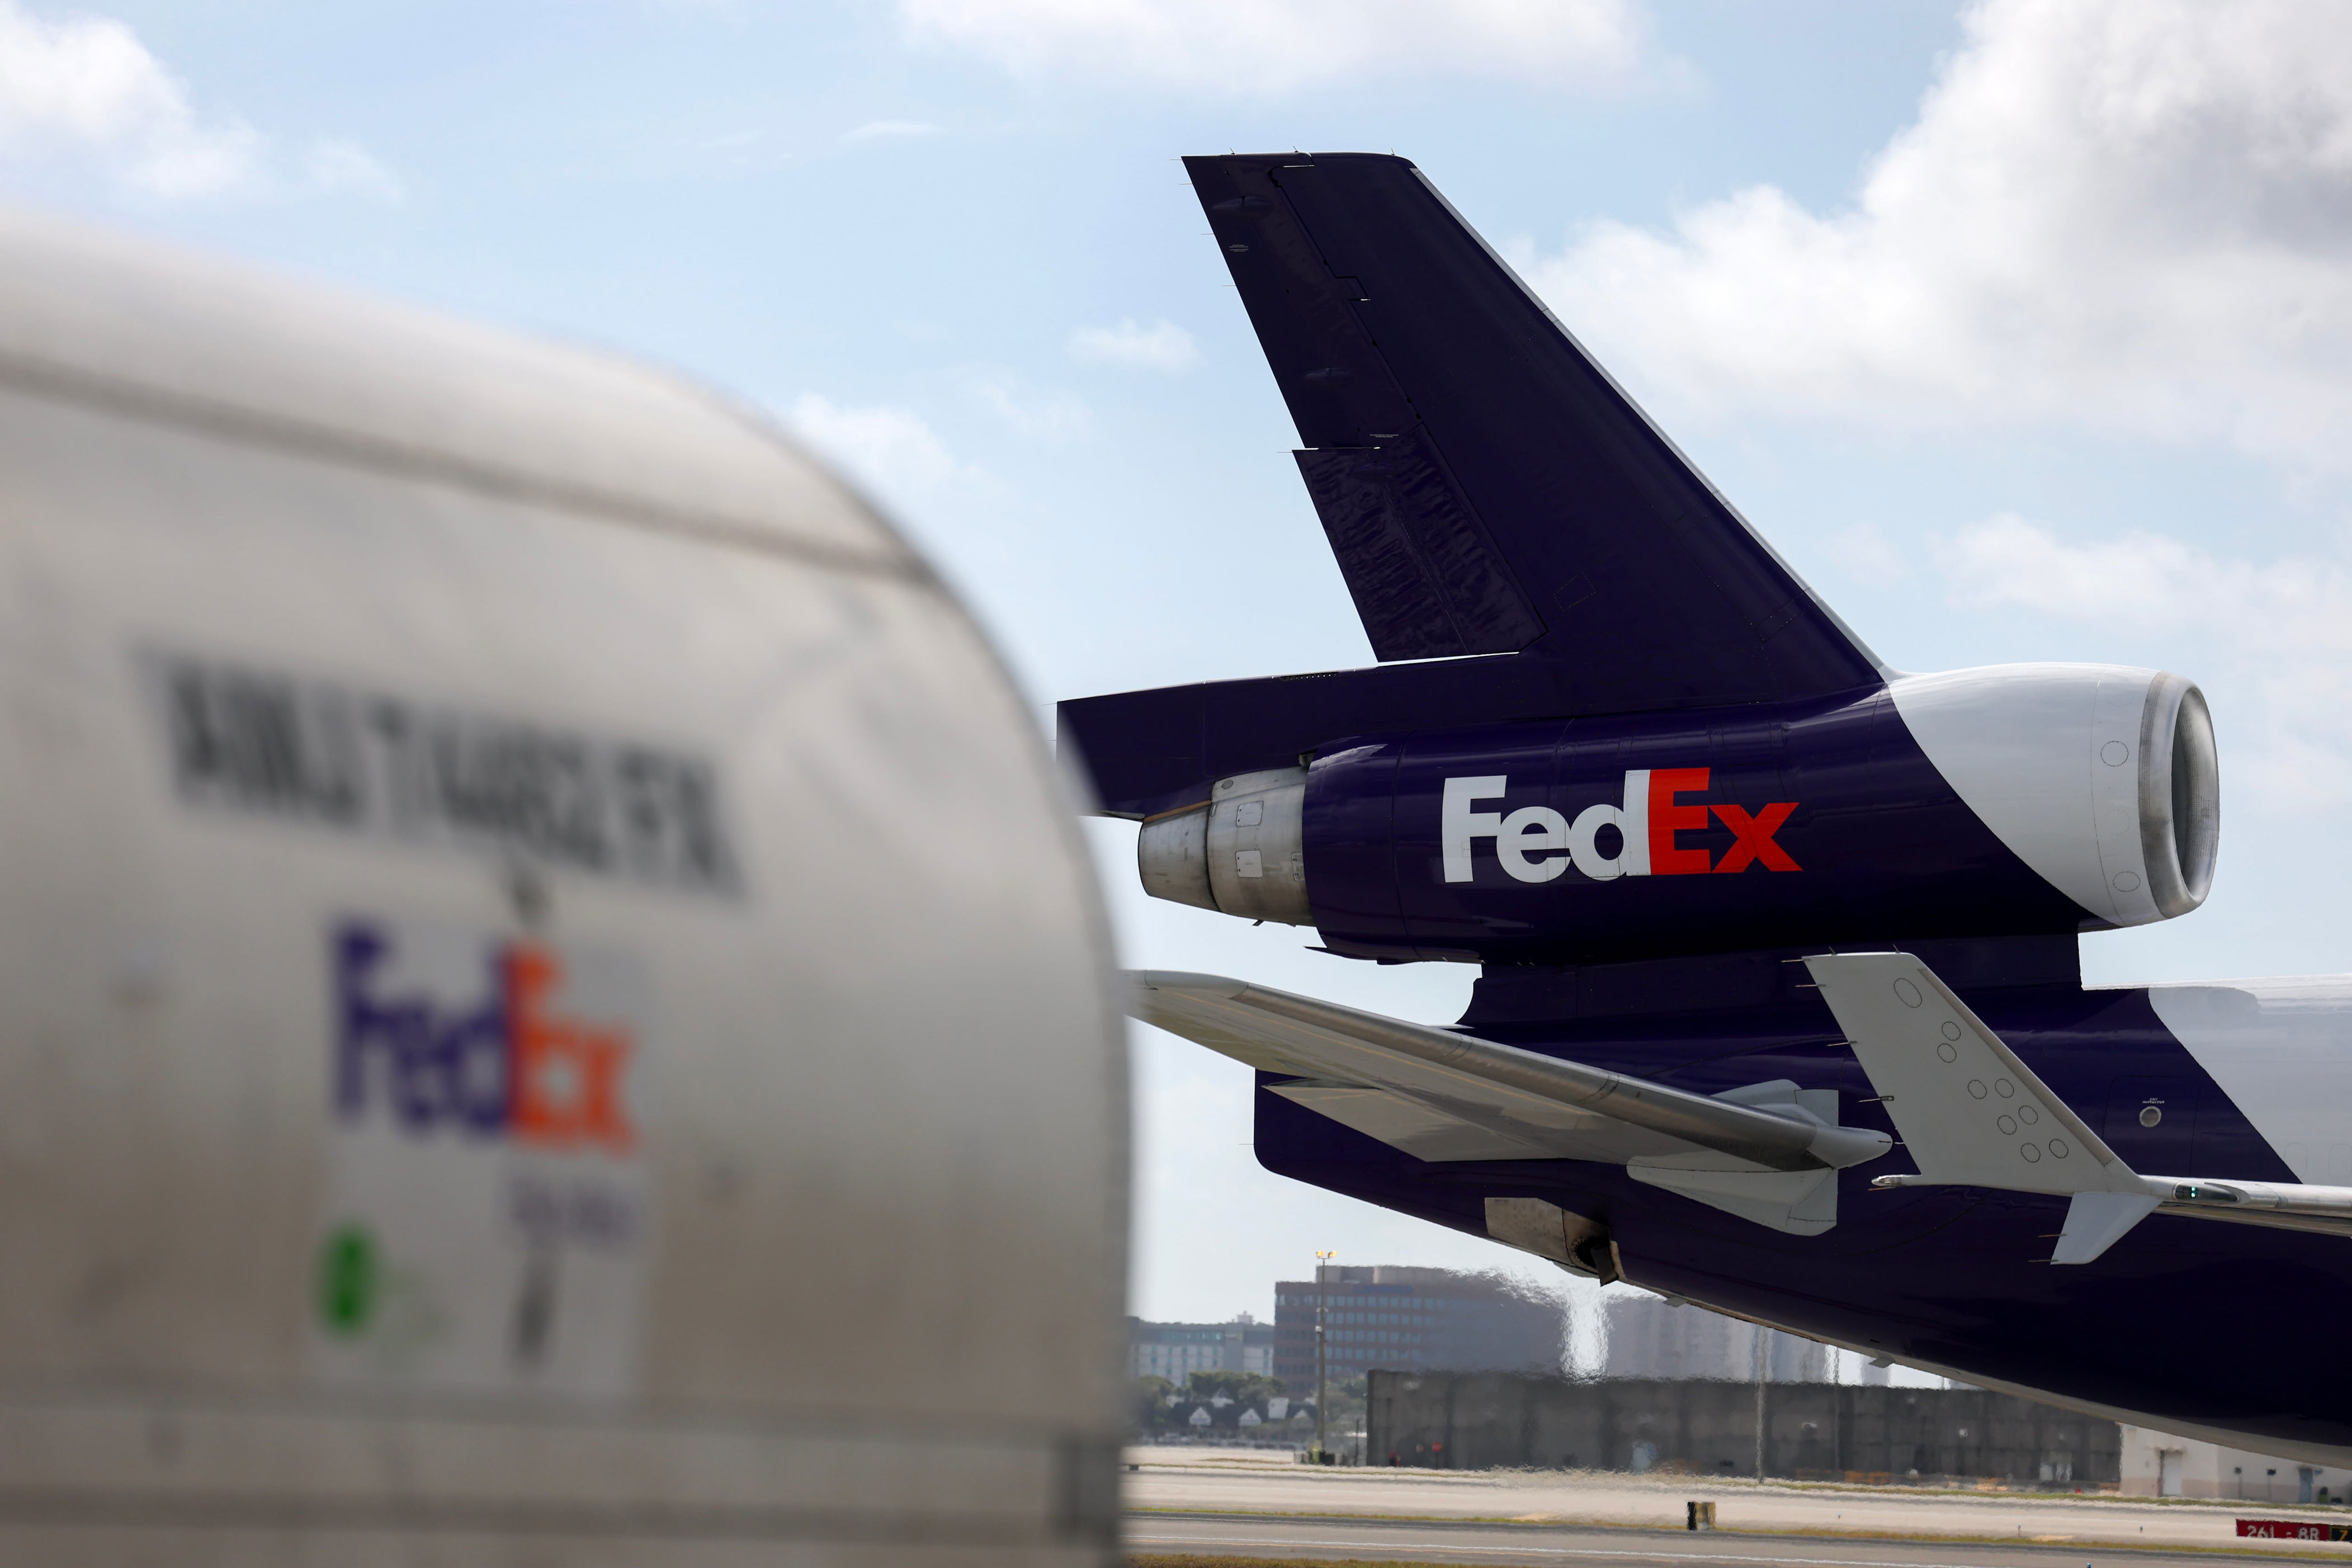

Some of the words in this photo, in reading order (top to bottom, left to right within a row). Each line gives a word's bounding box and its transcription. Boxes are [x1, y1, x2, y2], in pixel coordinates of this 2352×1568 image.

[1442, 767, 1803, 884] FedEx
[330, 916, 639, 1158] FedEx
[2298, 1527, 2320, 1541] 8R
